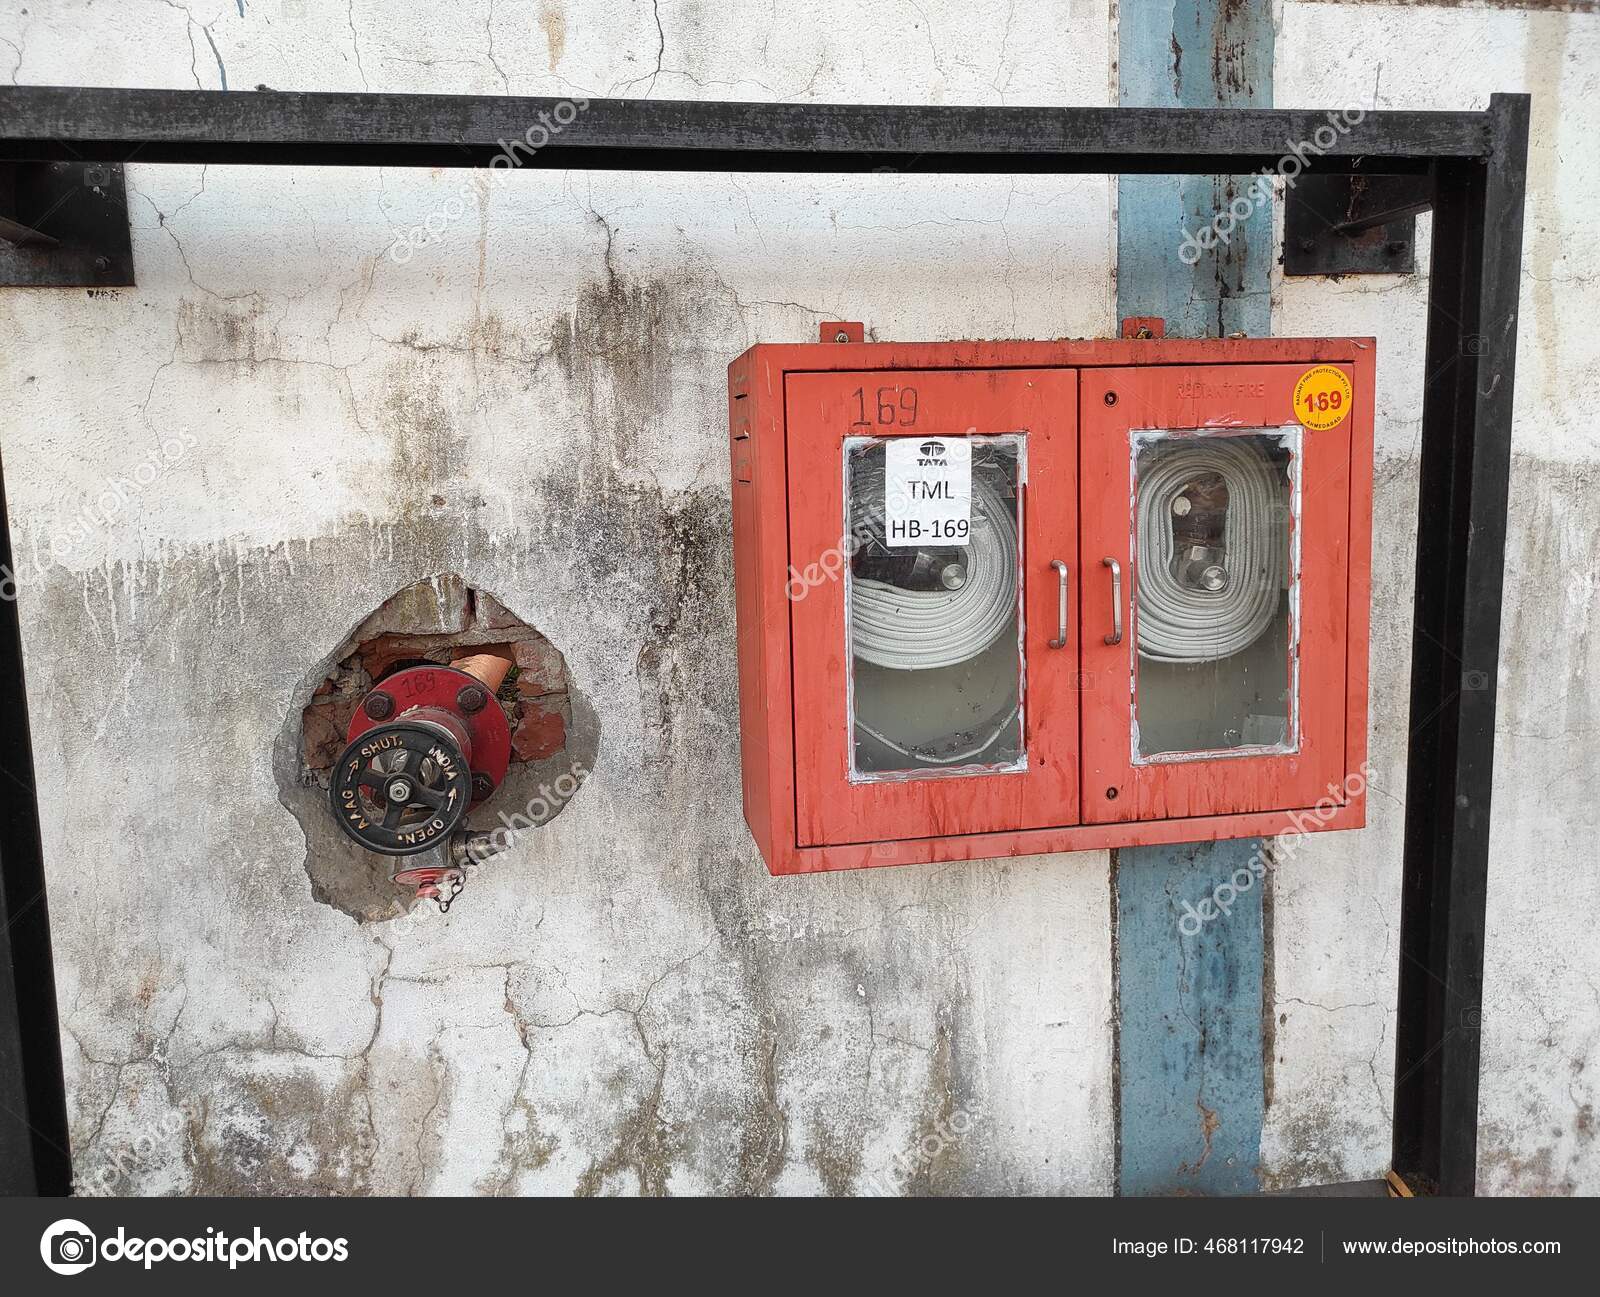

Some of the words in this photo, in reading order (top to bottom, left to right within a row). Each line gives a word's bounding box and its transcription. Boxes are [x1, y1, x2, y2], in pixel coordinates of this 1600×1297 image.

[1236, 383, 1265, 399] FIRE
[1303, 390, 1342, 412] 169
[852, 387, 918, 427] 169
[916, 458, 948, 466] TATA
[907, 480, 955, 500] TML
[892, 519, 969, 539] HB-169
[401, 672, 436, 698] 169
